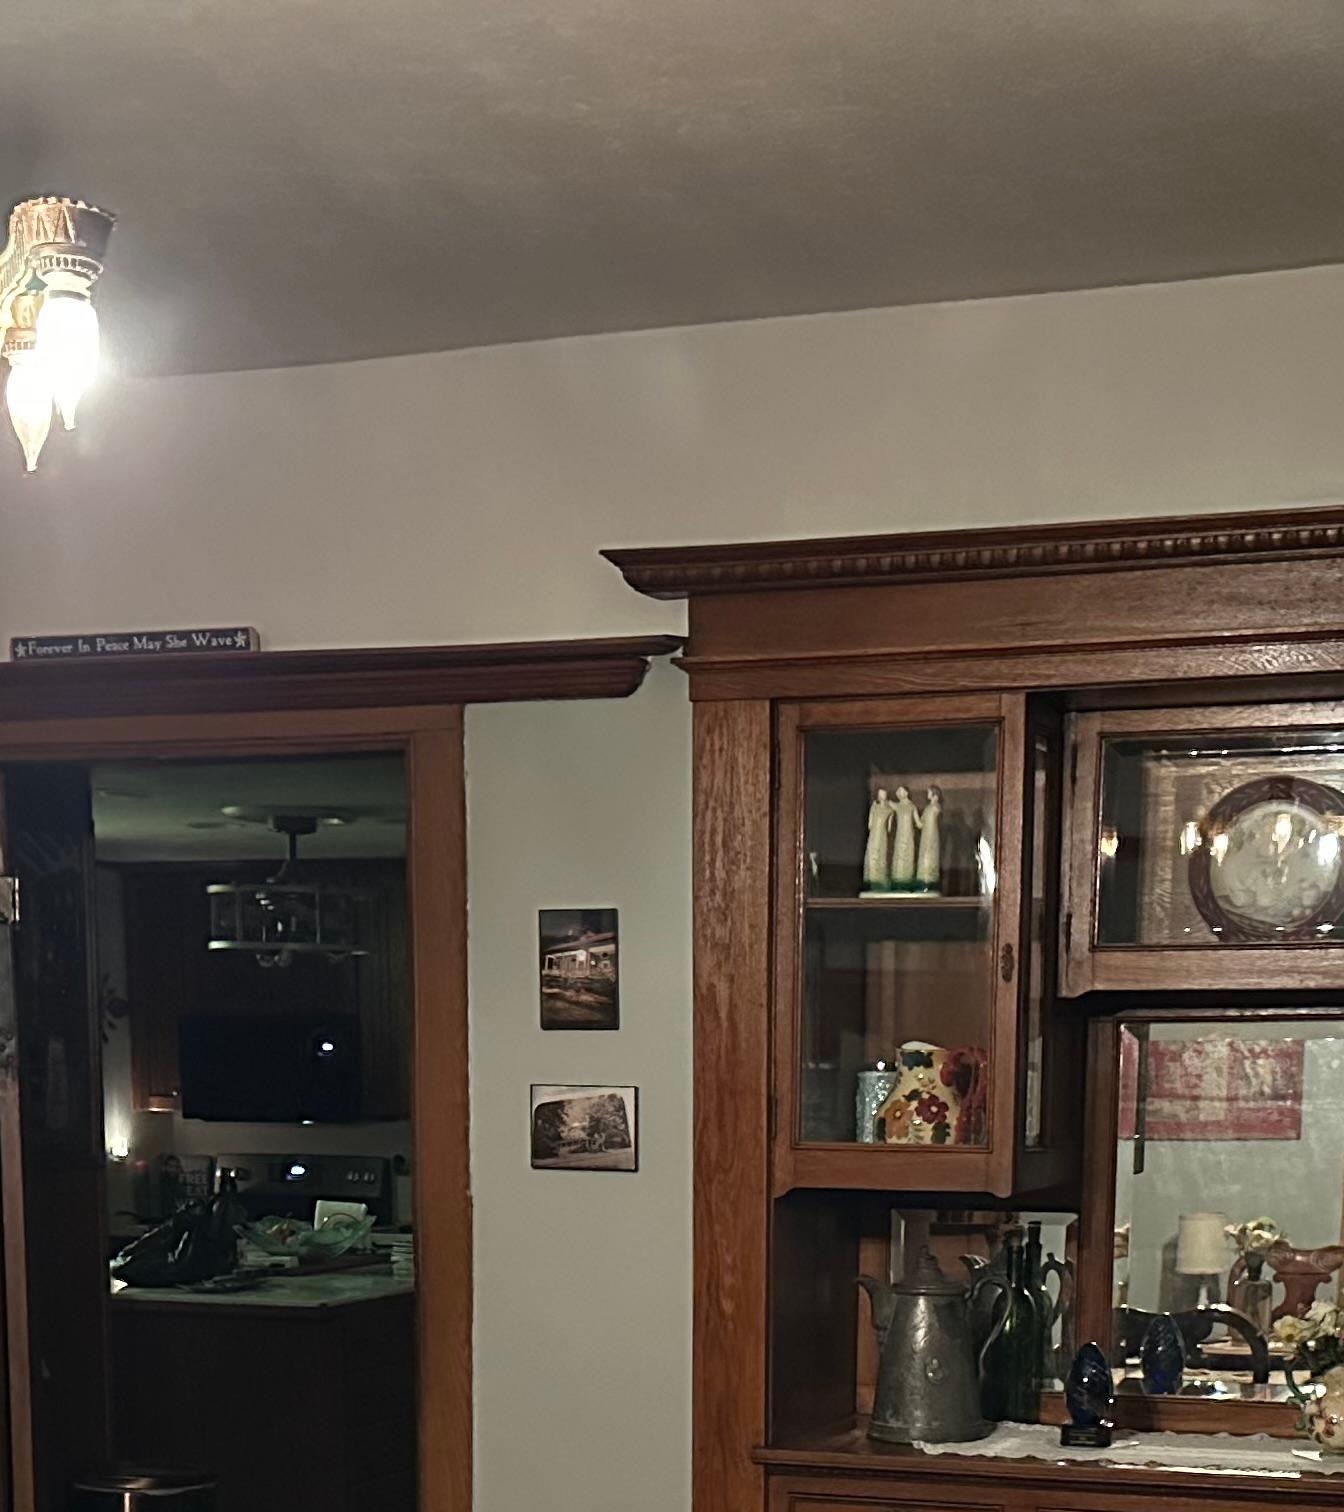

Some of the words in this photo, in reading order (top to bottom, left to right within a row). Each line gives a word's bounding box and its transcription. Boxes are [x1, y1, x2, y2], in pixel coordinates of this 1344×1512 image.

[77, 638, 92, 653] In
[96, 637, 129, 652] Peace
[133, 635, 162, 651] May
[166, 634, 187, 648] She
[192, 632, 233, 647] Wave
